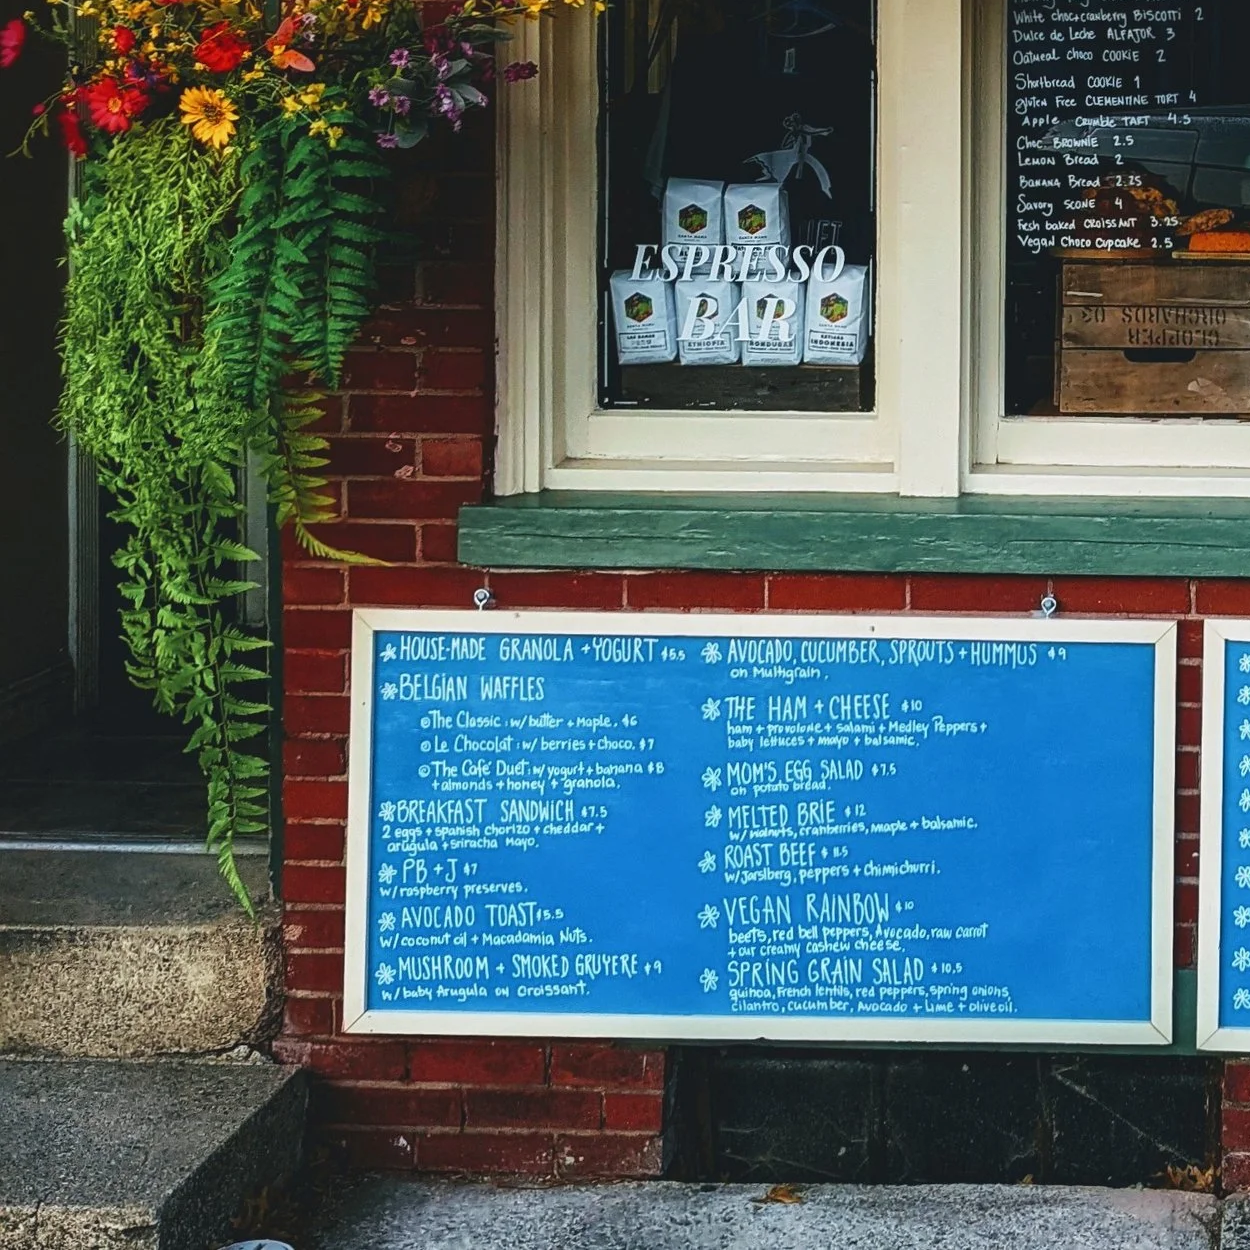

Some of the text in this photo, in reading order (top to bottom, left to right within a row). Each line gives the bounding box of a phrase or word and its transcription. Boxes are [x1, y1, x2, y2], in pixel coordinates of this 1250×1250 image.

[1015, 9, 1046, 25] White
[1194, 6, 1204, 21] 2
[1015, 26, 1176, 44] Dulce Leche ALFAJOR 3
[1155, 49, 1167, 63] 2
[1086, 75, 1123, 89] COOKIE
[1133, 75, 1140, 89] 1
[1084, 89, 1197, 107] CLEMENTINE TORT 4
[1122, 112, 1191, 126] TART 4.5
[1113, 136, 1134, 147] 2.5
[1064, 154, 1124, 166] Bread 2
[1068, 175, 1100, 188] Bread
[1115, 197, 1123, 210] 4
[1152, 238, 1173, 248] 2.5
[628, 244, 845, 283] ESPRESSO
[676, 296, 796, 342] BAR
[811, 339, 854, 347] INDONESIA
[401, 636, 574, 662] HOUSE-MADE GRANOLA
[888, 638, 1037, 669] SPROUTS HUMMUS
[480, 676, 545, 701] WAFFLES
[768, 693, 890, 722] HAM CHEESE
[456, 710, 501, 728] Classic
[434, 734, 586, 753] Le Chocolat berries
[595, 762, 643, 775] banana
[727, 759, 863, 786] MOM'S EGG SALAD
[506, 777, 545, 795] honey
[397, 798, 487, 824] BREAKFAST
[581, 805, 608, 818] $7.5
[728, 805, 789, 829] MELTED
[435, 821, 594, 840] spanish chorizo cheddar
[387, 839, 438, 856] arugula
[724, 842, 816, 869] ROAST BEEF
[403, 858, 428, 884] PB
[401, 901, 537, 928] AVOCADO TOAST
[723, 892, 889, 926] VEGAN RAINBOW
[482, 930, 555, 946] Macadamia
[798, 922, 989, 939] bell carrot
[398, 953, 638, 981] MUSHROOM SMOKED GRUYERE
[872, 957, 924, 985] SALAD
